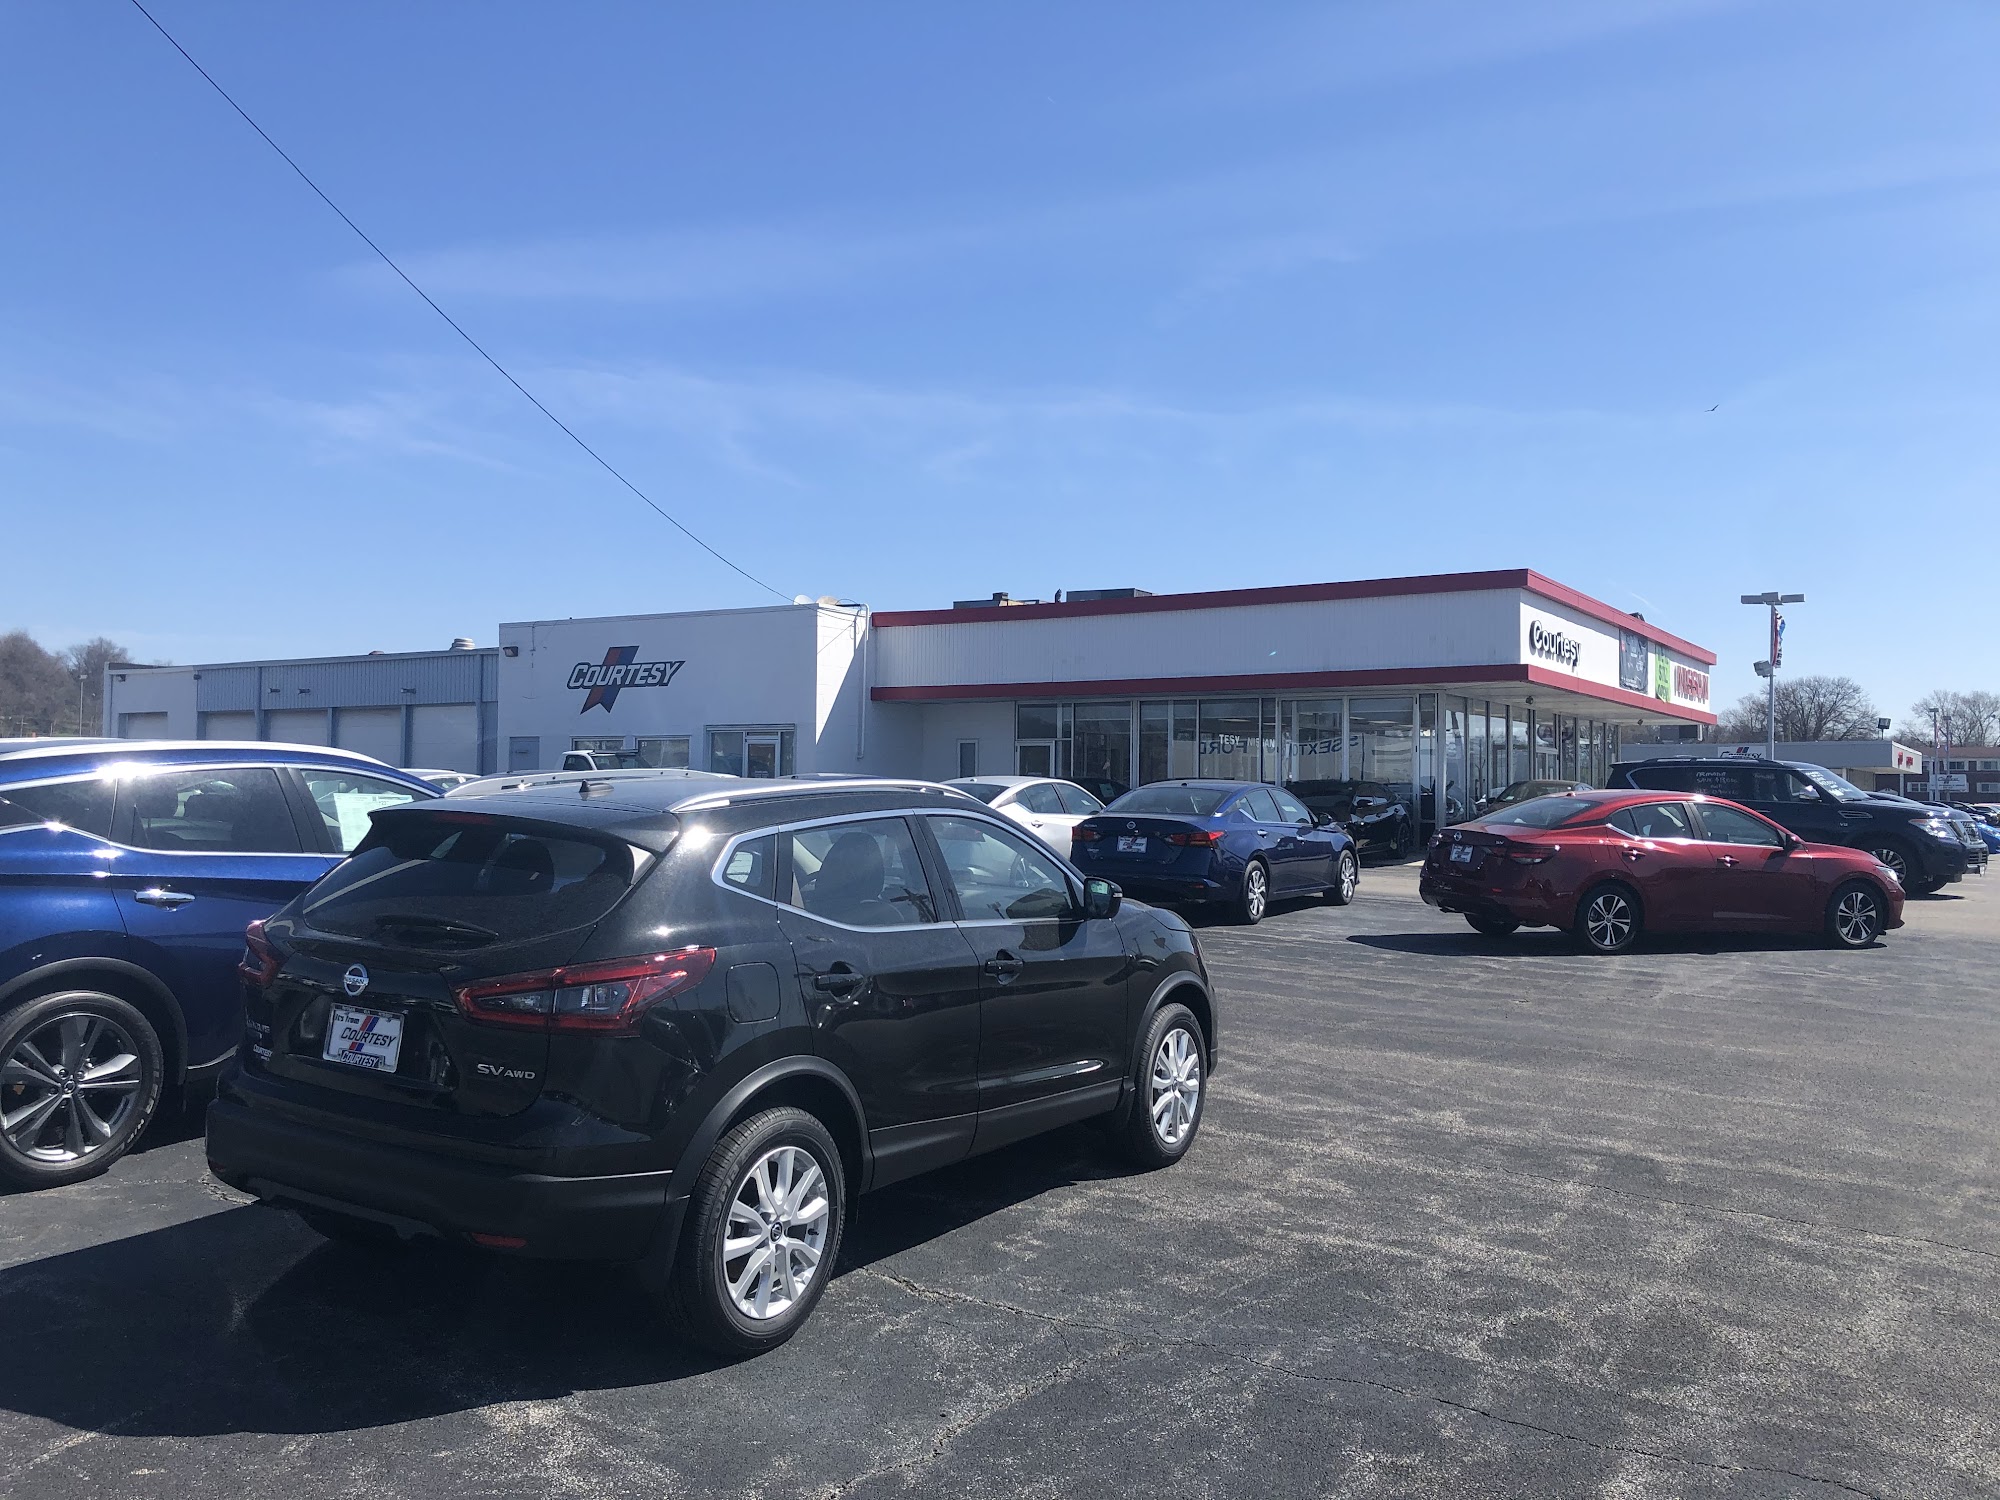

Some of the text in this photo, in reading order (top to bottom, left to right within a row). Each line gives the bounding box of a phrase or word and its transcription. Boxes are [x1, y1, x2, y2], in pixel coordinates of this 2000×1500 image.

[1531, 620, 1581, 666] Courtesy
[567, 661, 685, 688] COURTESY
[1219, 734, 1240, 746] TESY
[341, 1027, 397, 1047] COURTESY
[341, 1051, 379, 1068] COURTESY
[477, 1063, 536, 1080] SV AWD
